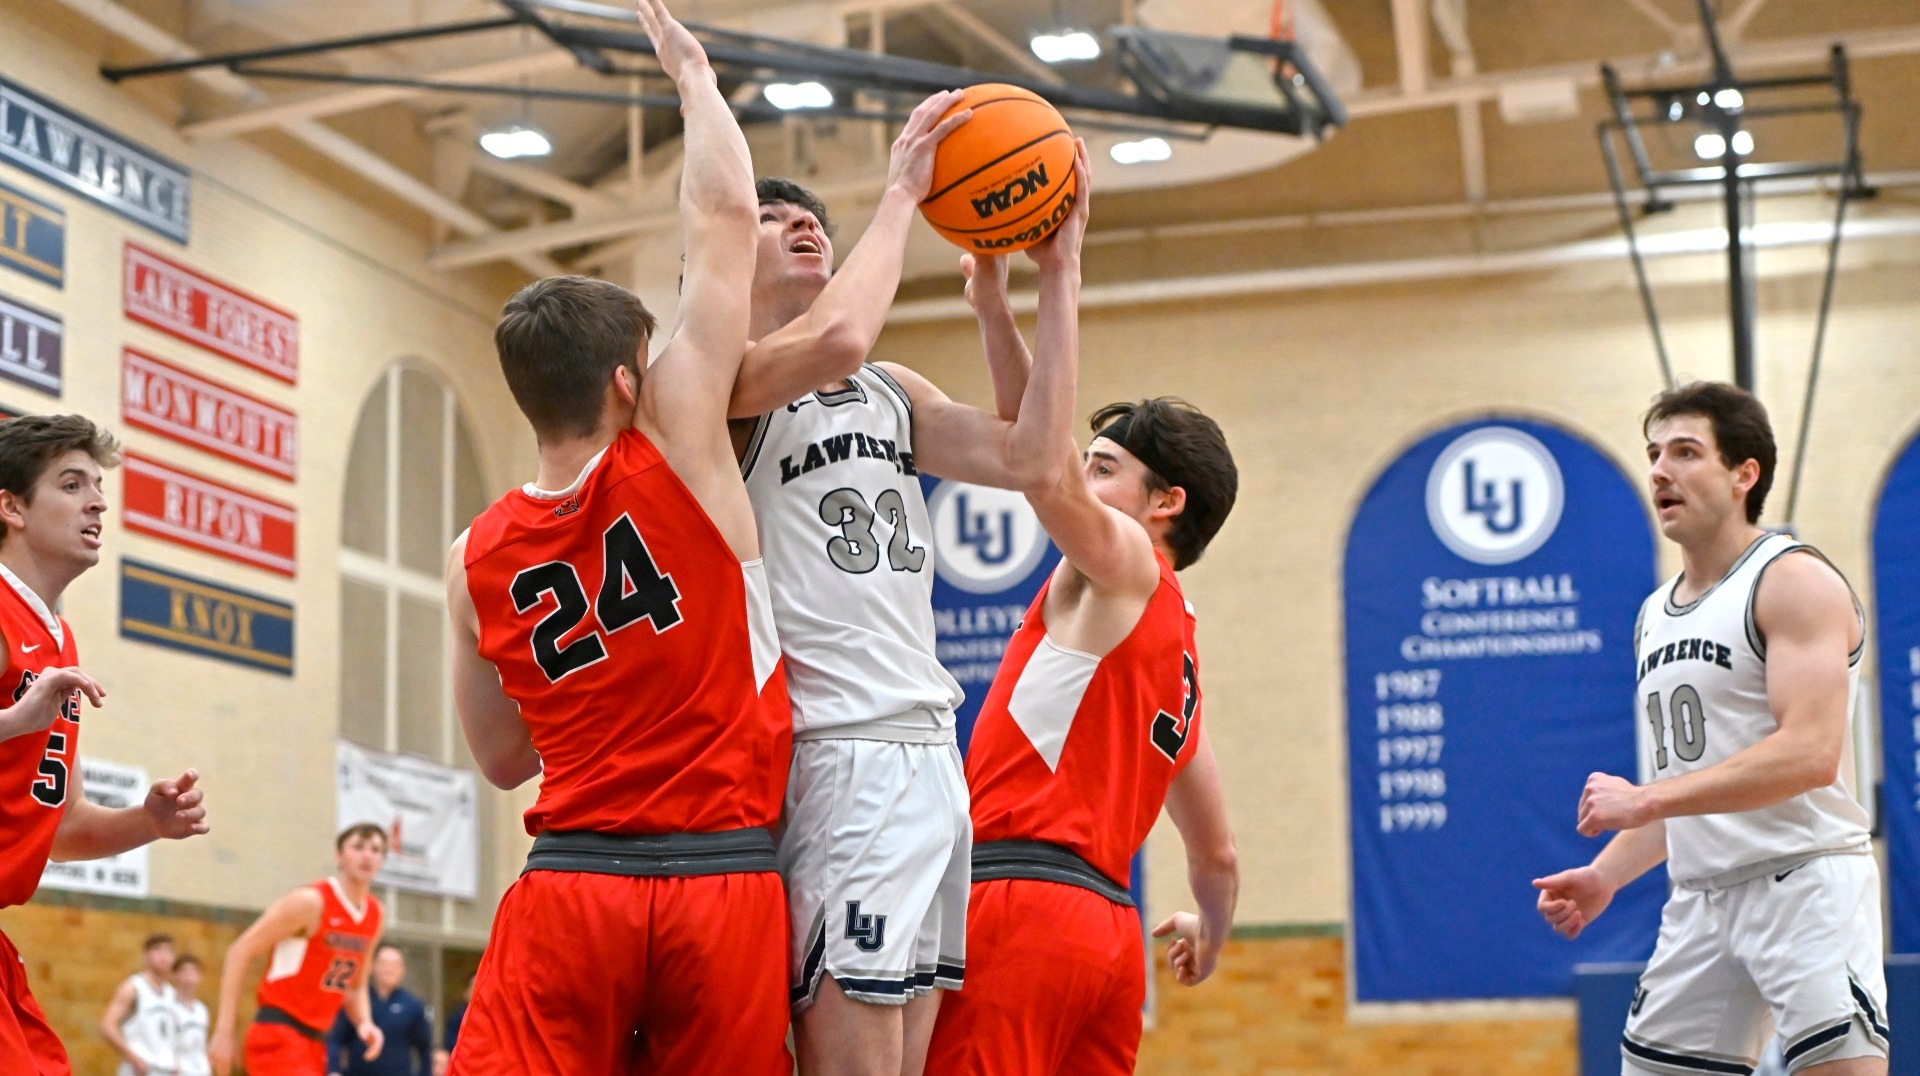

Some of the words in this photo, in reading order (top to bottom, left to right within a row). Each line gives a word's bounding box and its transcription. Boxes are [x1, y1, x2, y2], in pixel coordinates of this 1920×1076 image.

[0, 99, 188, 223] LAWRENCE
[970, 162, 1049, 219] NCAA
[126, 256, 192, 327] LAKE
[206, 293, 297, 372] FOREST
[124, 363, 296, 465] MONMOUTH
[164, 480, 263, 550] RIPON
[1459, 458, 1524, 535] LU
[819, 487, 926, 574] 32
[954, 491, 1014, 566] LU
[169, 589, 255, 647] KNOX
[509, 511, 684, 684] 24
[1421, 574, 1579, 609] SOFTBALL
[1401, 628, 1602, 662] CHAMPIONSHIPS
[1421, 606, 1578, 638] CONFERENCE
[1376, 669, 1443, 700] 1987
[1377, 702, 1444, 733] 1988
[1647, 684, 1706, 770] 10
[30, 731, 68, 809] 5
[1378, 735, 1445, 767] 1997
[1379, 768, 1447, 799] 1998
[1380, 801, 1448, 833] 1999
[844, 900, 888, 952] LU
[321, 957, 357, 990] 22
